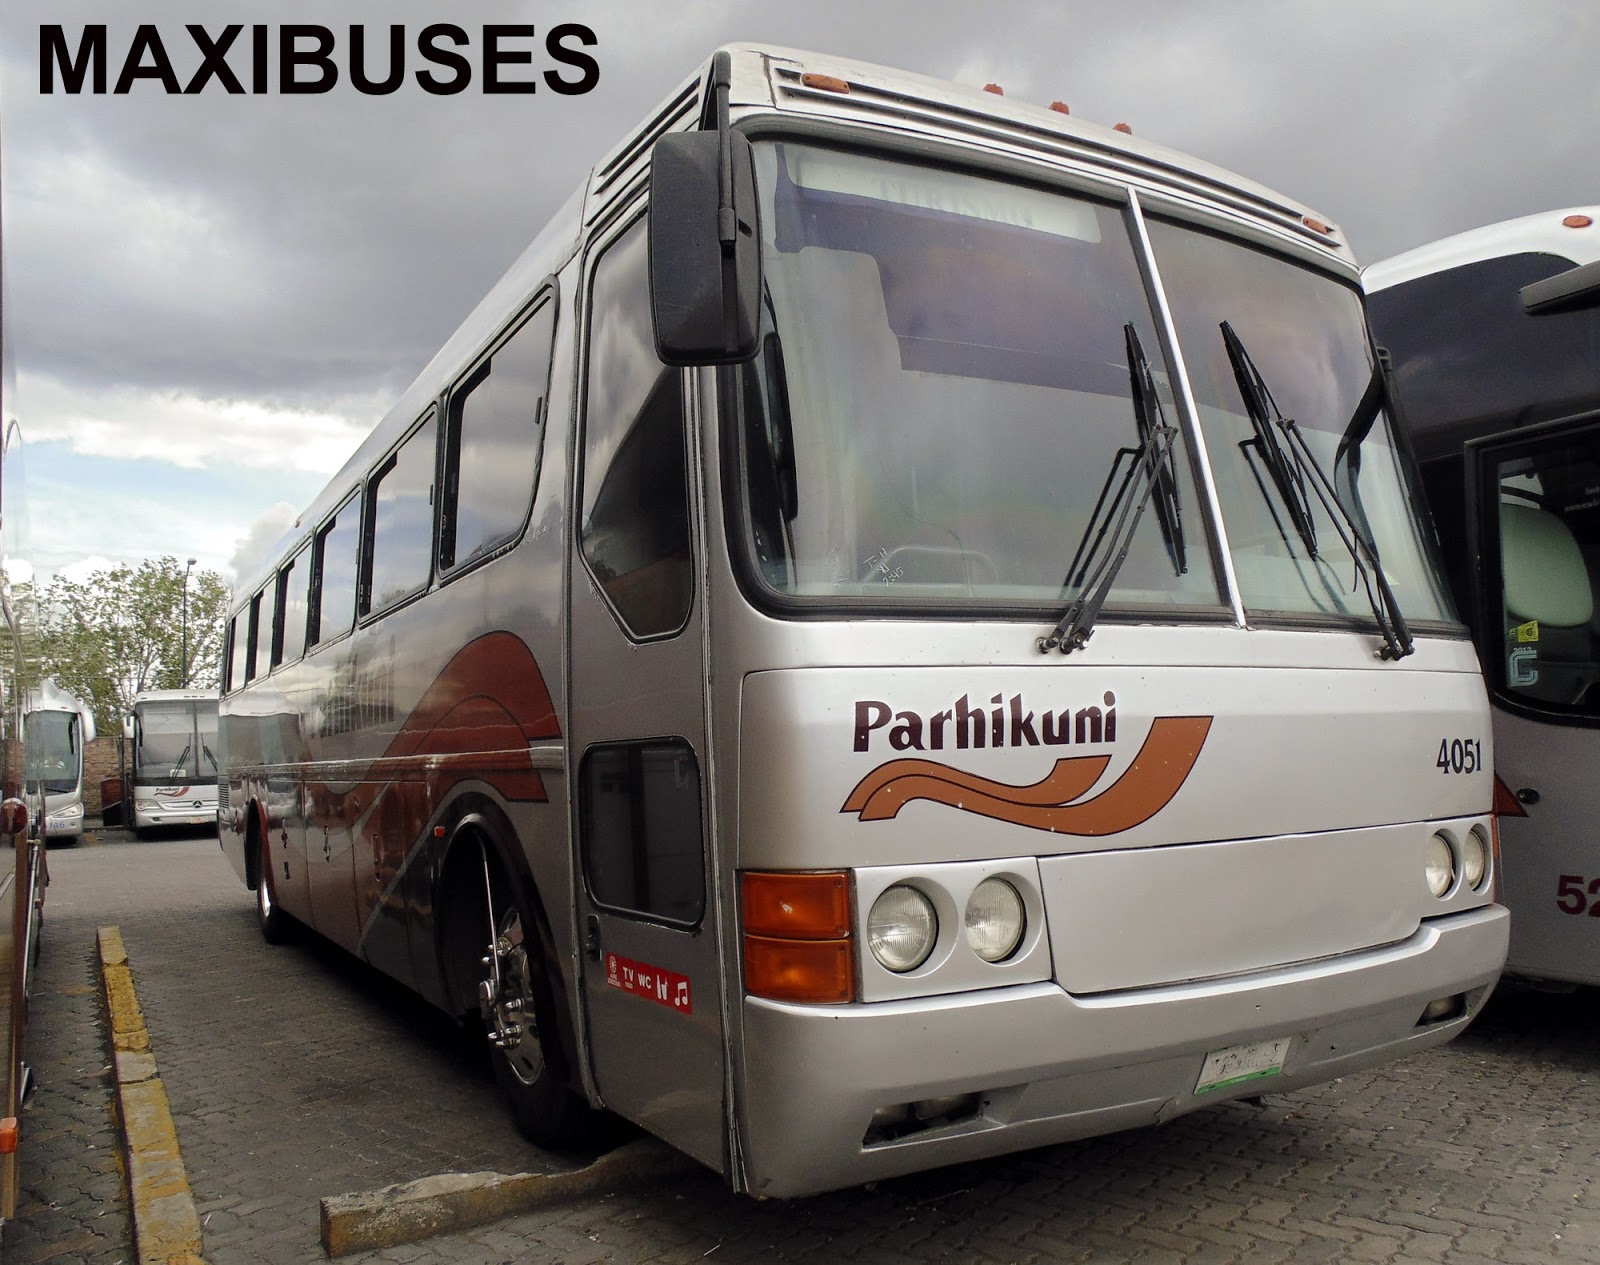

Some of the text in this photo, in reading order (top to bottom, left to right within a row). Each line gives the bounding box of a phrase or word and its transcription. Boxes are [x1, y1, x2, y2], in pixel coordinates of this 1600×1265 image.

[853, 690, 1117, 752] Parhikuni
[1436, 738, 1482, 774] 4051
[622, 966, 634, 982] TV
[637, 972, 652, 990] WC
